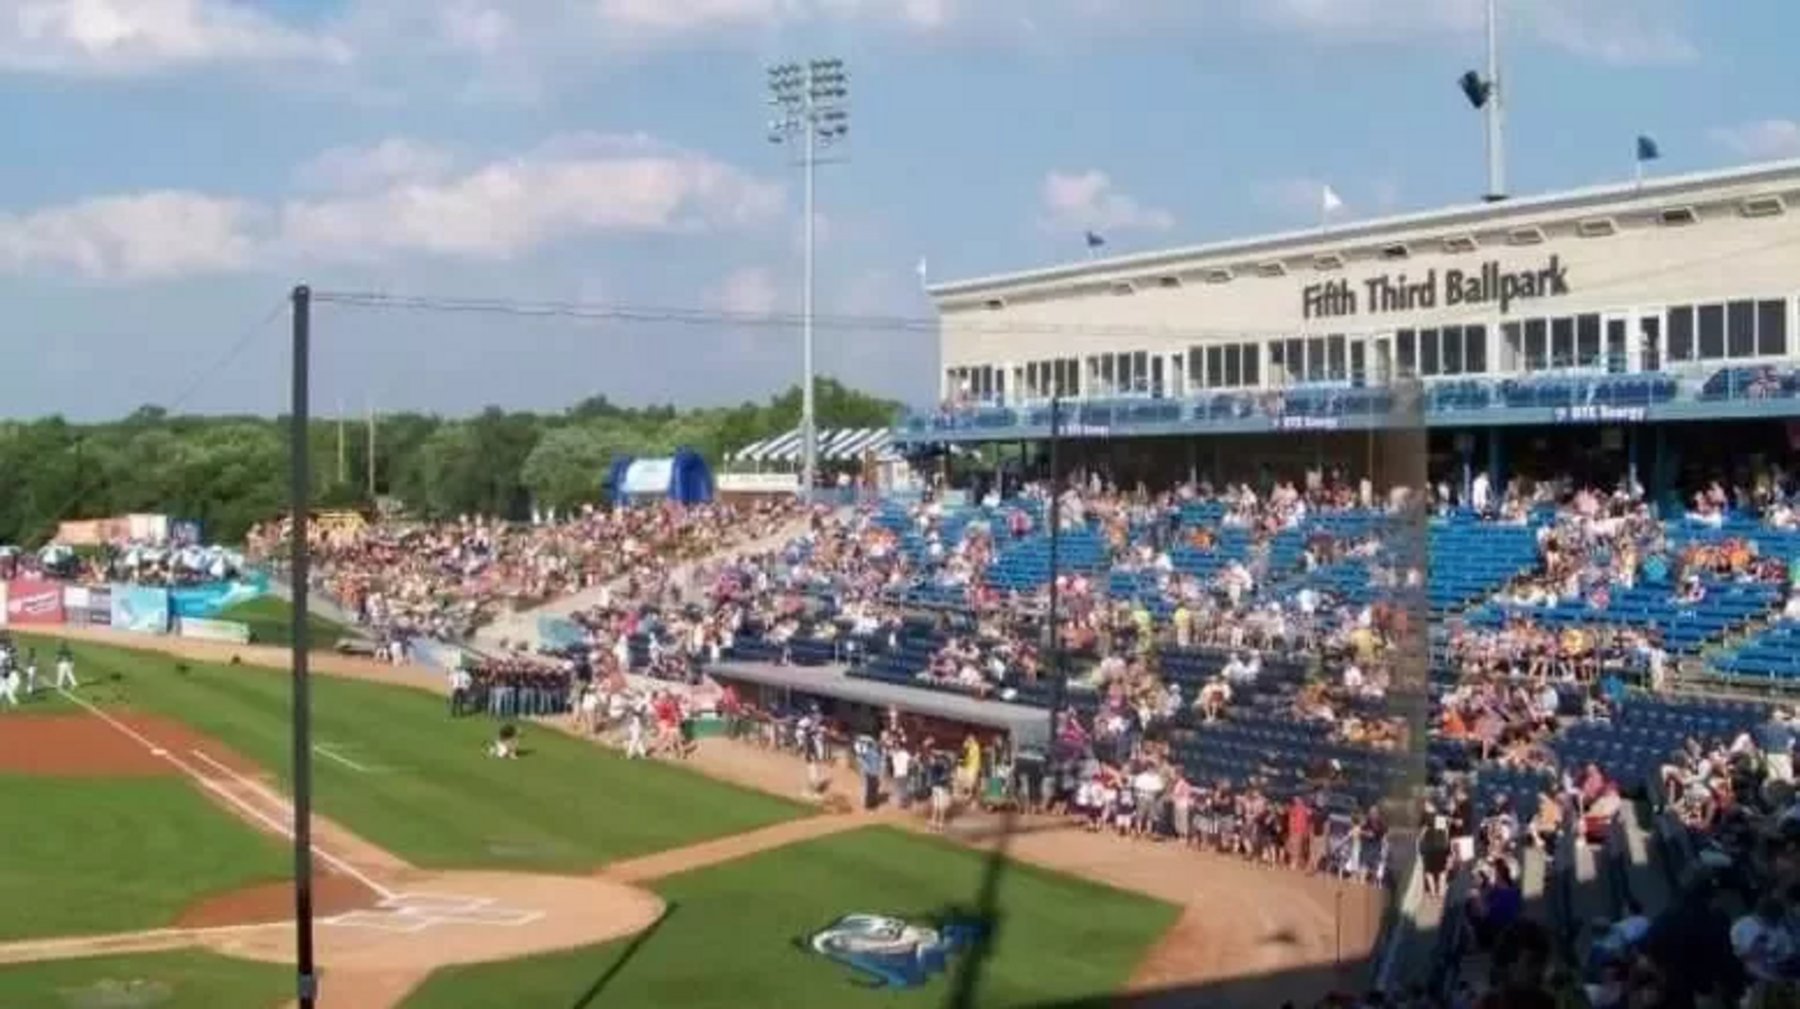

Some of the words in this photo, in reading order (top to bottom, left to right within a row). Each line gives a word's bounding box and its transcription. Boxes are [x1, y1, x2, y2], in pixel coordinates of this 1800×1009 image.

[1302, 277, 1357, 319] Fifth
[1365, 268, 1437, 313] Third
[1445, 253, 1569, 312] Ballpark
